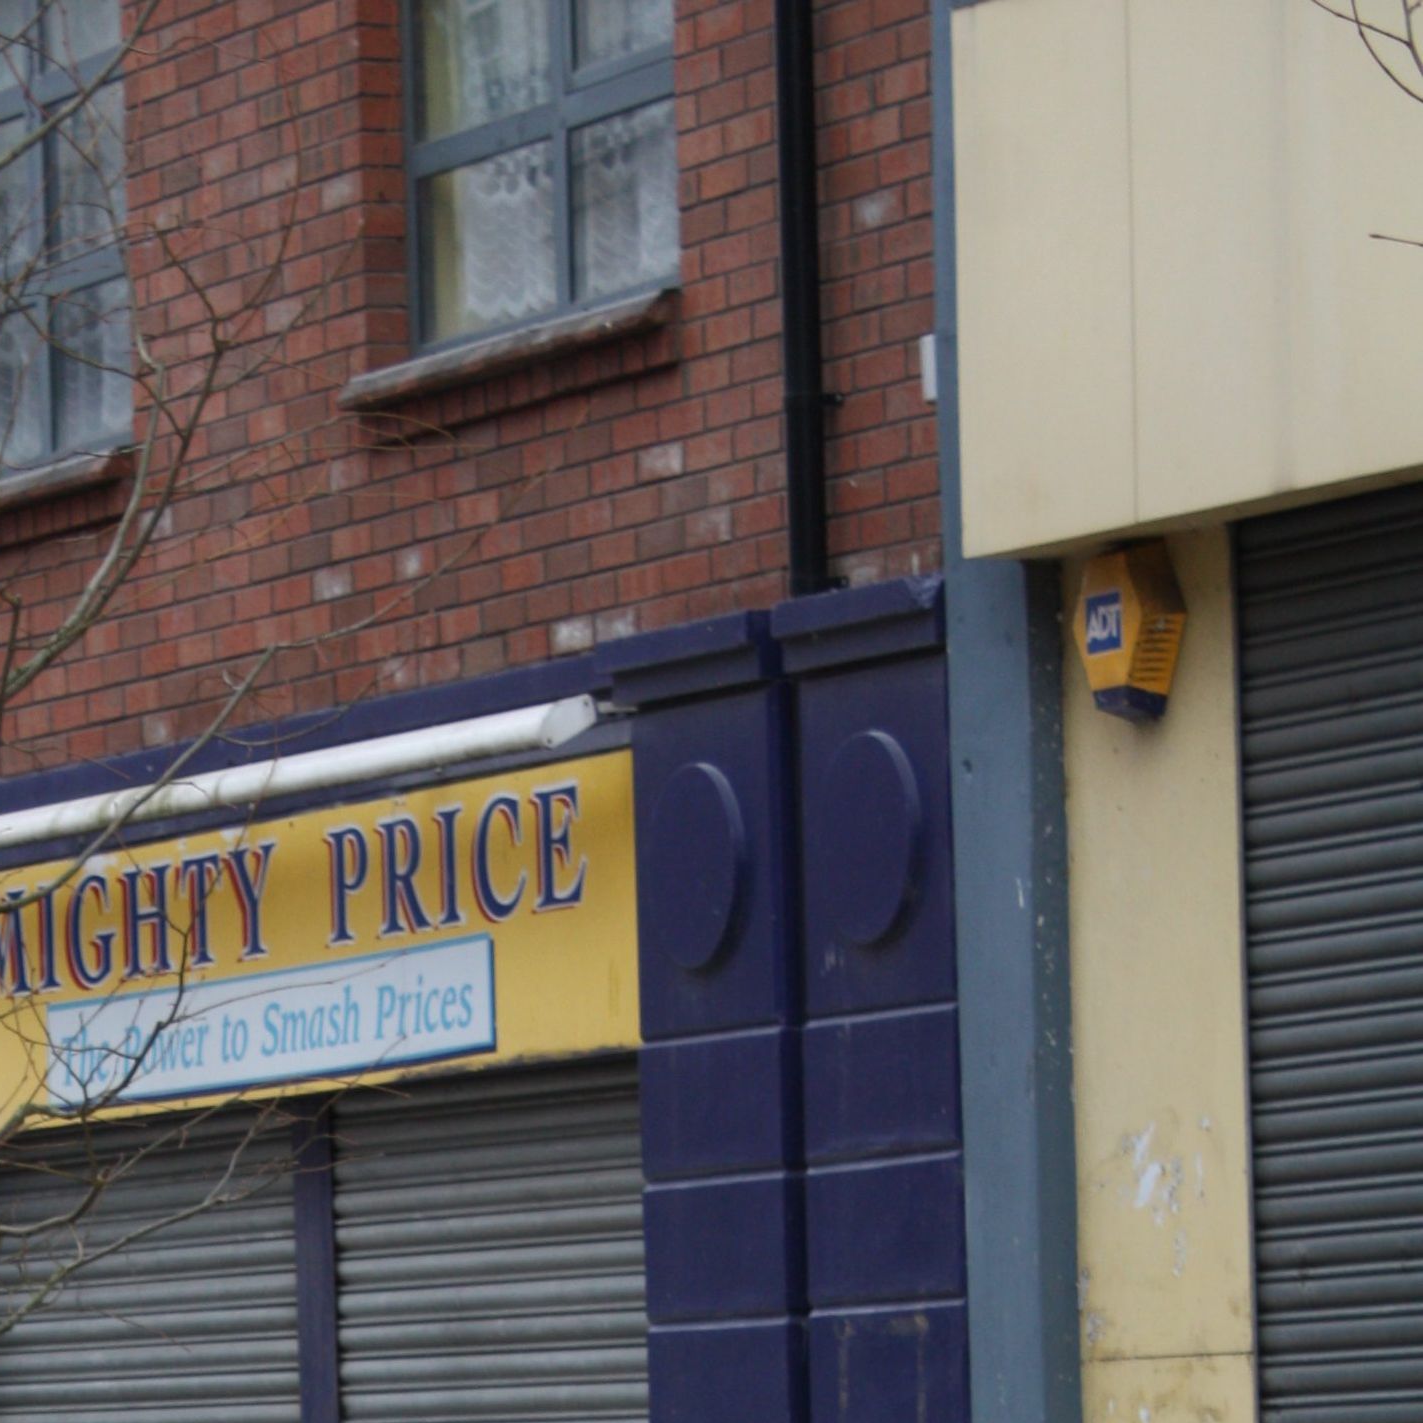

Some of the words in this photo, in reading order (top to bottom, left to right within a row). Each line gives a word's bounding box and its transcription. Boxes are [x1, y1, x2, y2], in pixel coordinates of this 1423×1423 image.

[1087, 604, 1121, 644] ADT
[323, 781, 589, 948] PRICE
[62, 1025, 108, 1087] The
[124, 1023, 210, 1075] Power
[222, 1015, 248, 1063] to
[261, 984, 361, 1056] Smash
[376, 974, 474, 1041] Prices
